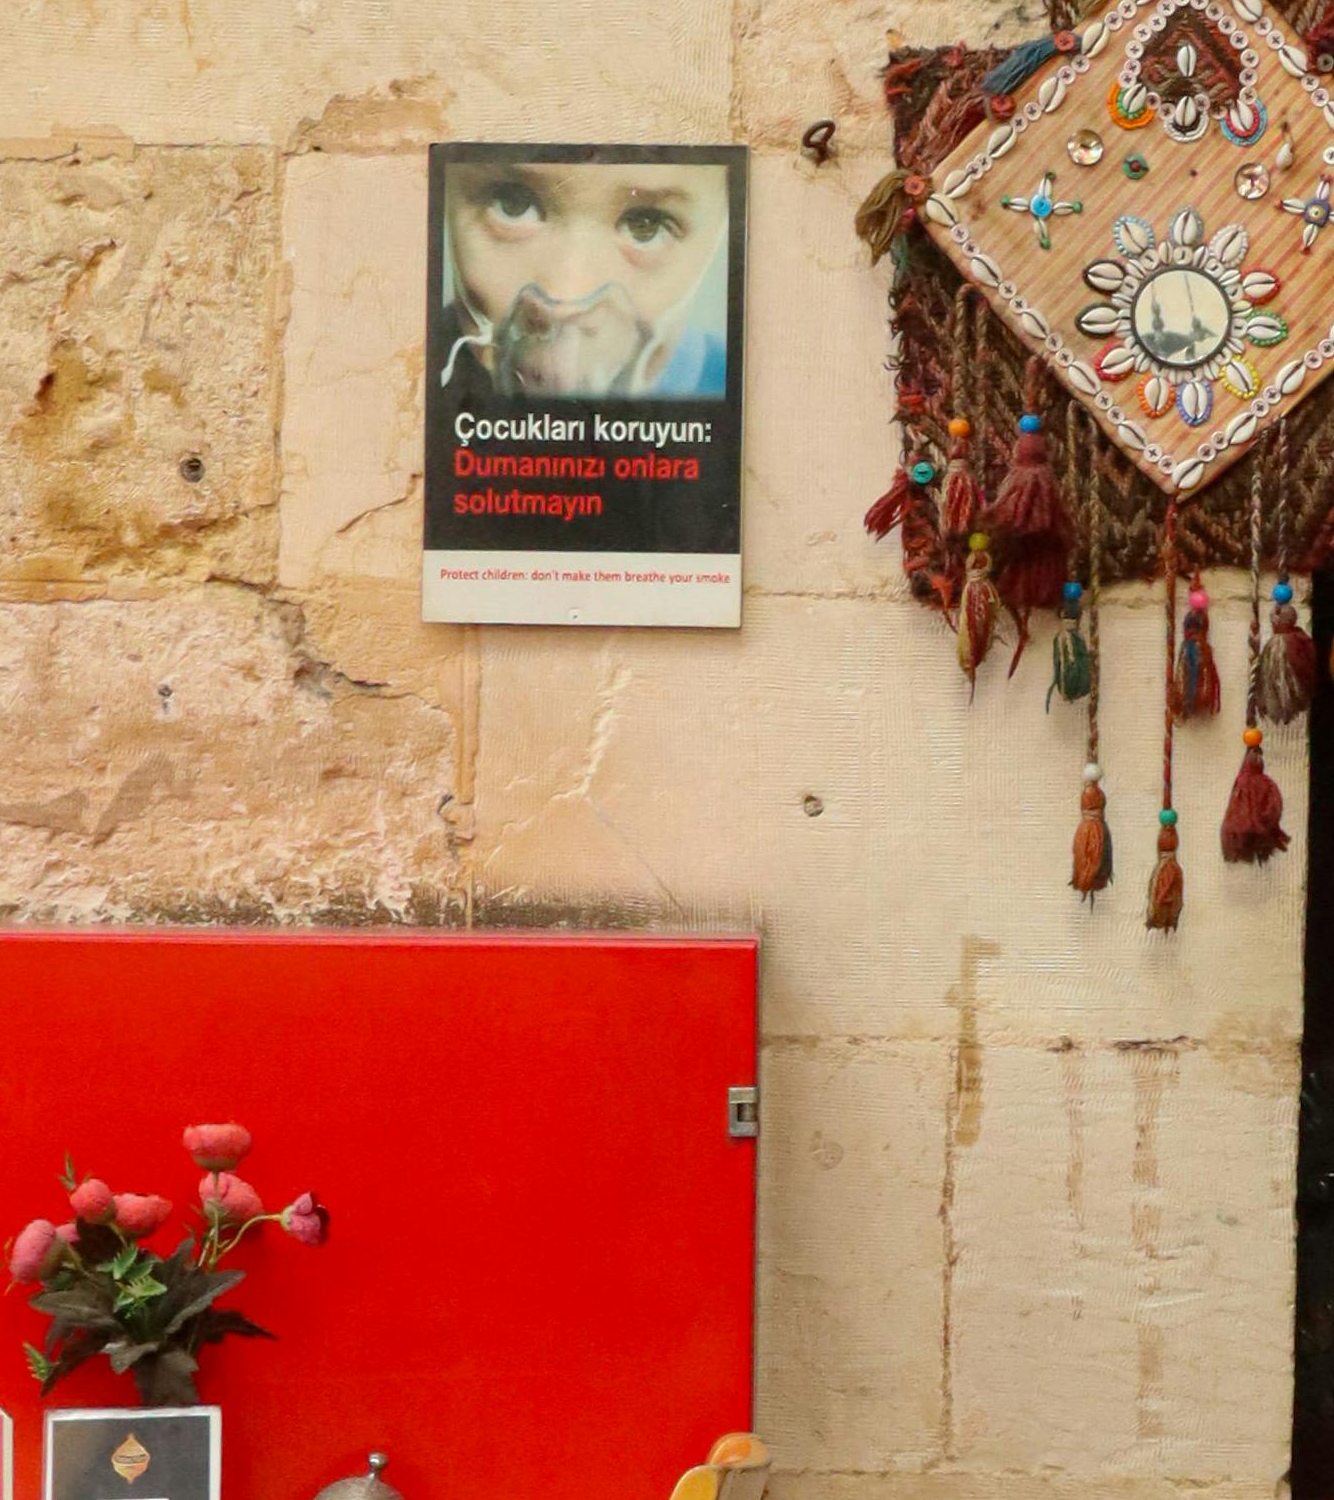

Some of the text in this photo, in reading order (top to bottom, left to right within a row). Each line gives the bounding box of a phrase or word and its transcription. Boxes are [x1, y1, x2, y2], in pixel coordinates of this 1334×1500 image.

[454, 412, 712, 448] Çocukları koruyun:
[454, 447, 701, 481] Dumanınızı onlara
[453, 486, 604, 522] solutmayın
[440, 568, 731, 585] Protect children: don't make them breathe your smoke
